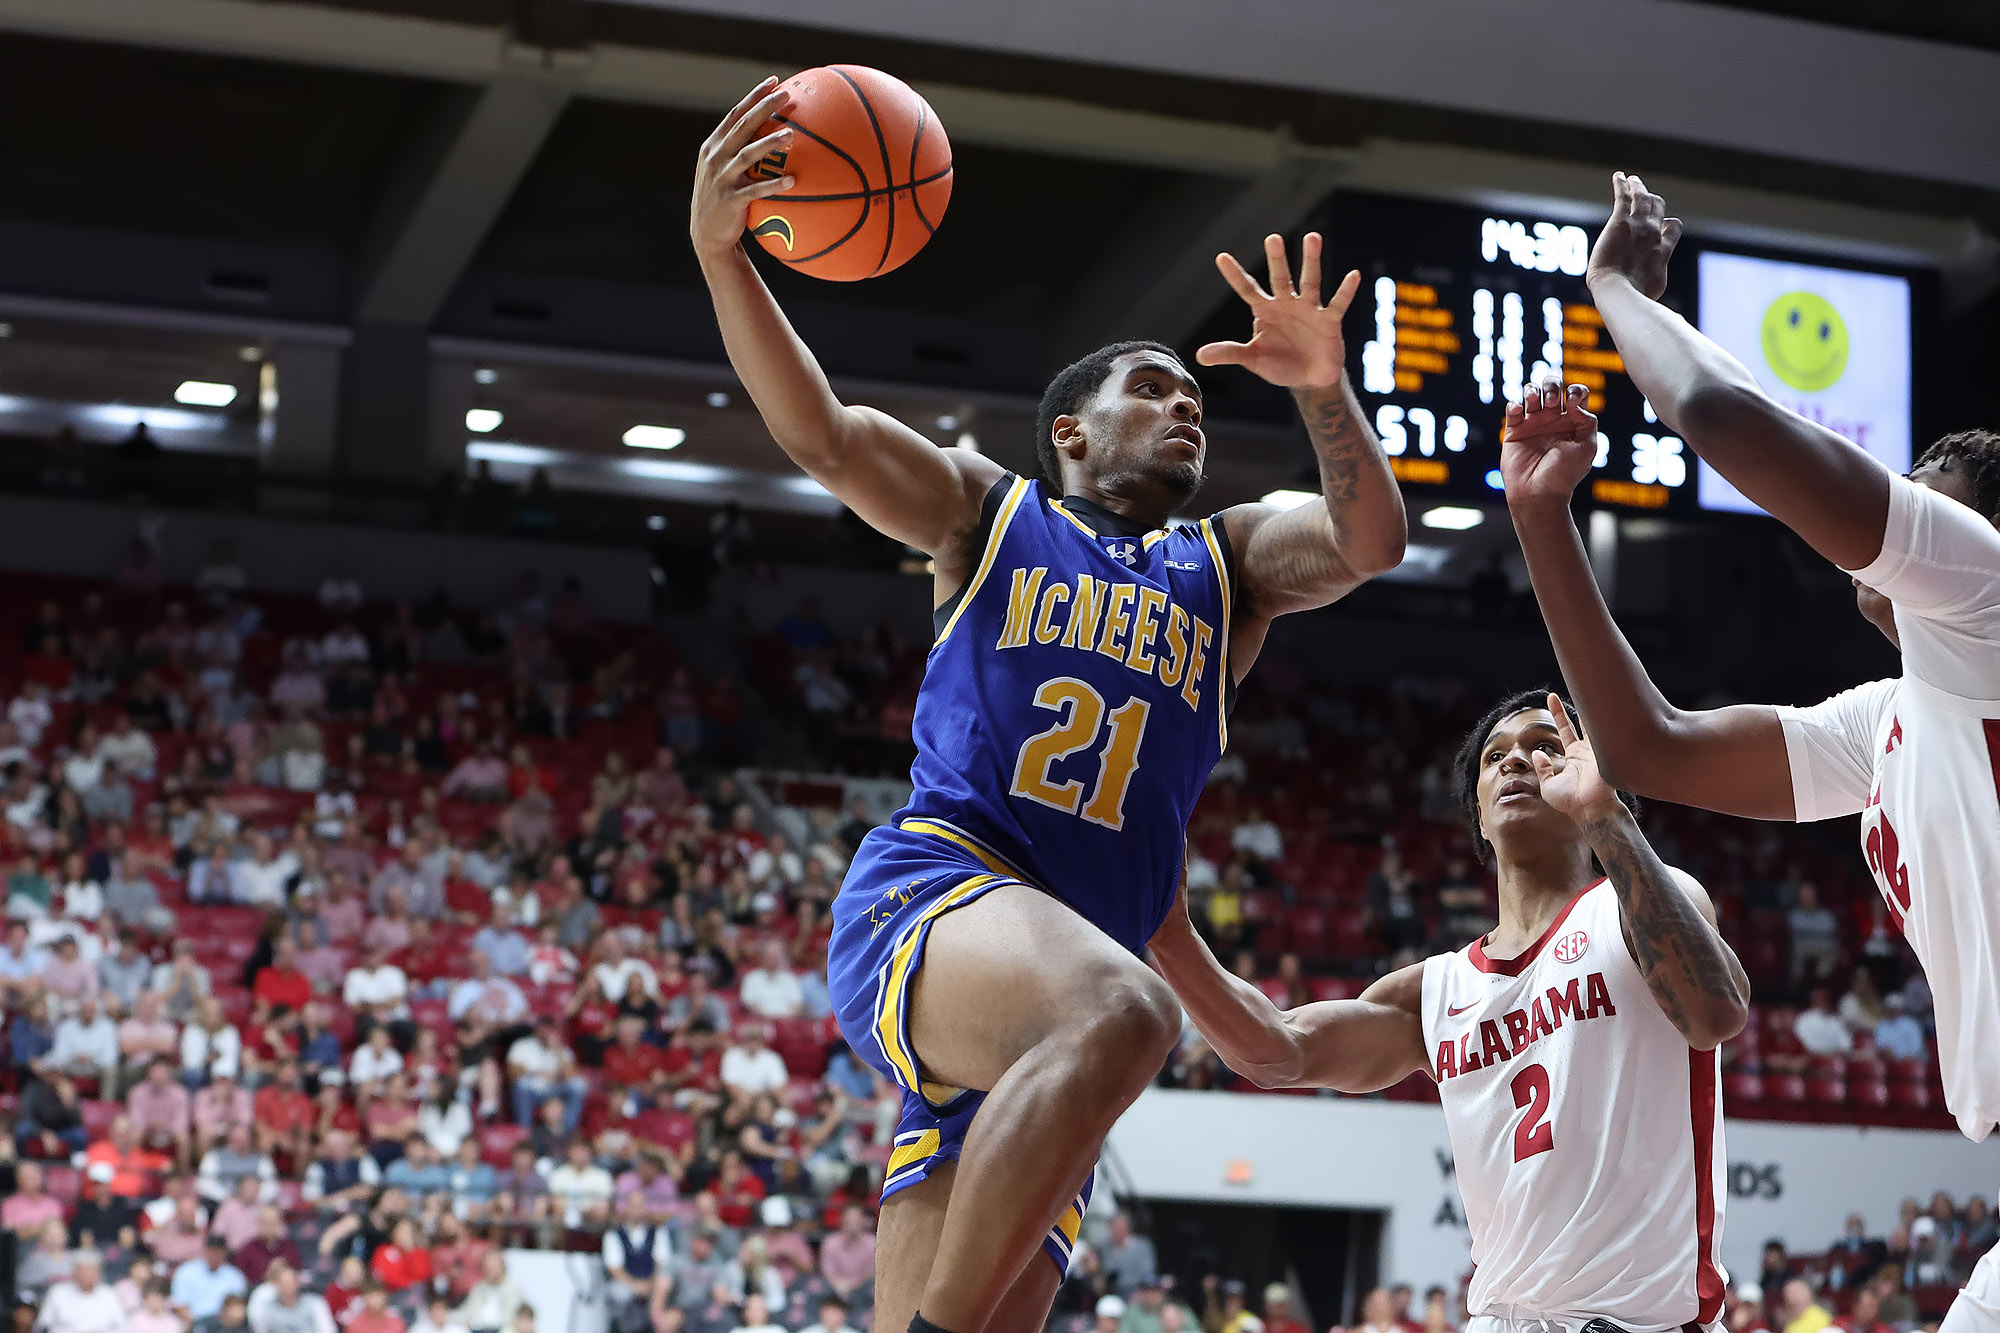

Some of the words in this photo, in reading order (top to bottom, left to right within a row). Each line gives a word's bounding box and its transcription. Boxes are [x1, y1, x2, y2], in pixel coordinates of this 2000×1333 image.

[1376, 404, 1435, 456] 57
[1631, 433, 1685, 486] 36
[1009, 676, 1151, 832] 21
[1554, 931, 1588, 961] SEC
[1436, 972, 1616, 1083] ALABAMA
[1510, 1063, 1554, 1163] 2
